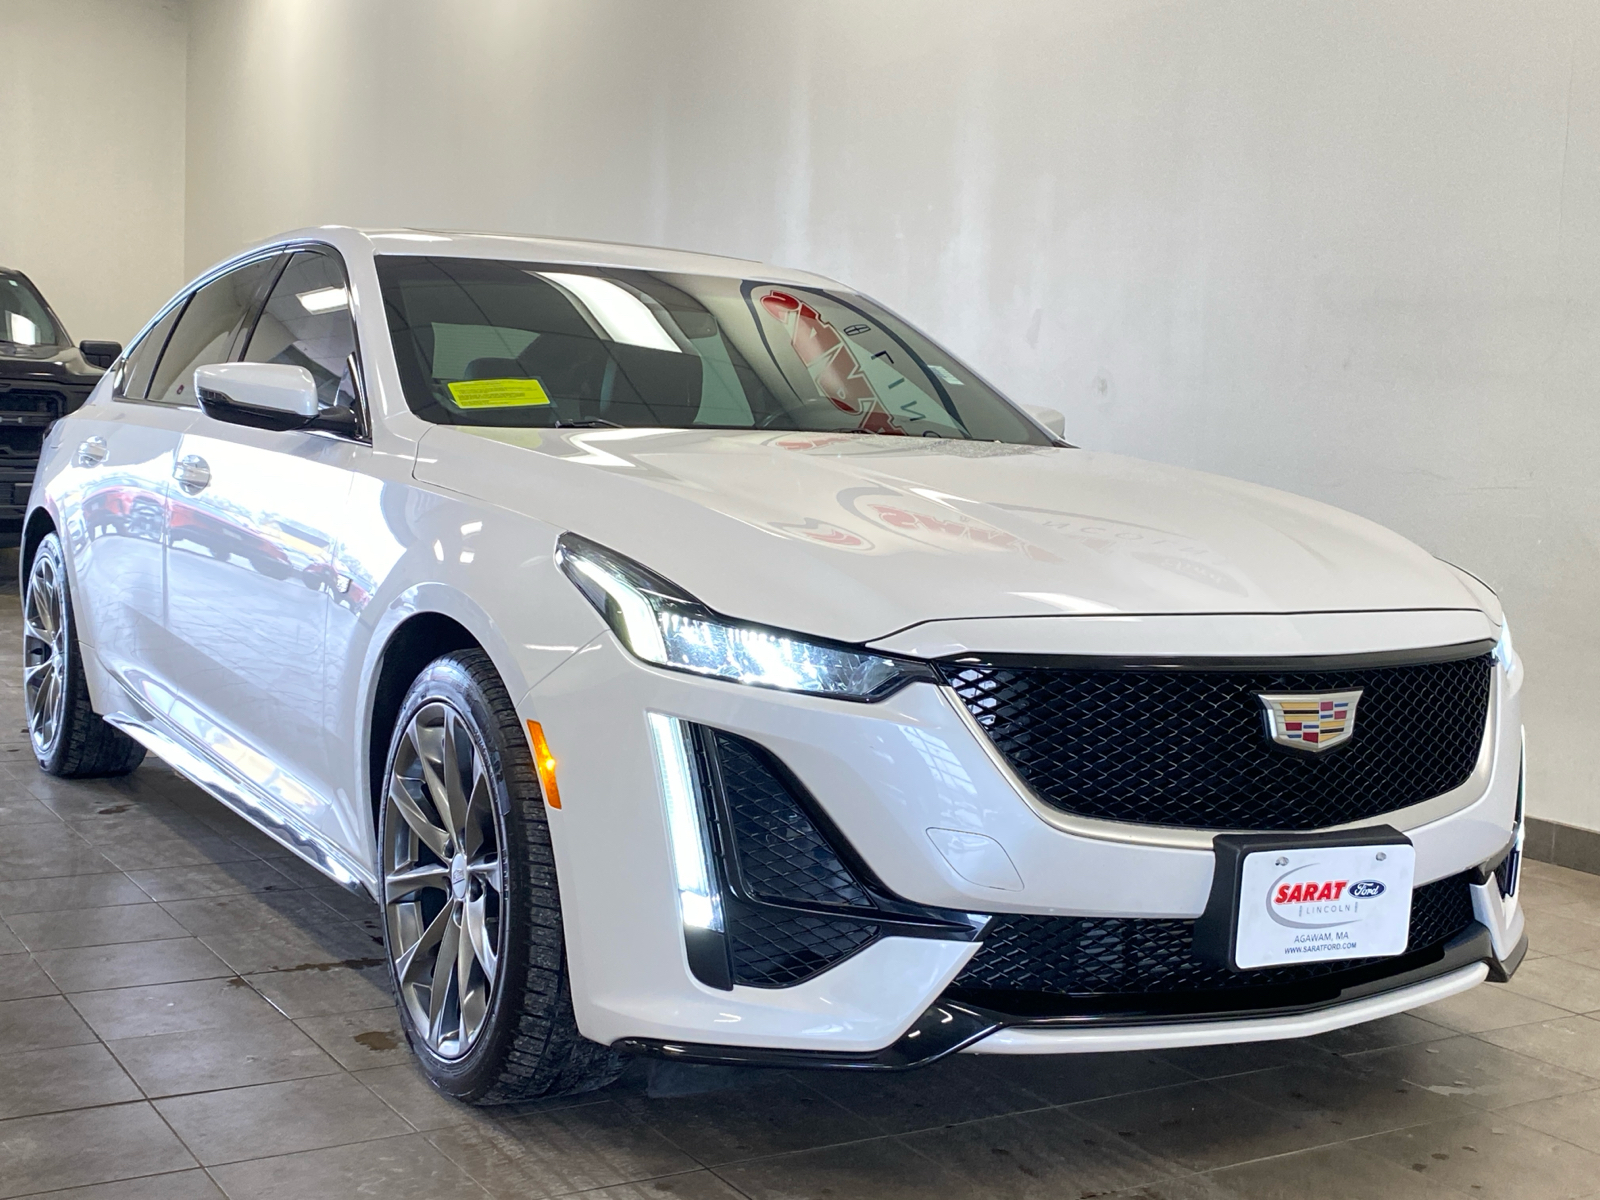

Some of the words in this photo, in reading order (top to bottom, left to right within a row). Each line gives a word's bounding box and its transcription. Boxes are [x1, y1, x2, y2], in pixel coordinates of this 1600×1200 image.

[1275, 881, 1349, 904] SARAT
[1354, 882, 1379, 896] Ford
[1306, 905, 1351, 914] LINCOLN
[1294, 933, 1334, 943] AGAWAM,
[1336, 931, 1349, 940] MA
[1285, 943, 1357, 954] WWW.SARATFORD.COM
